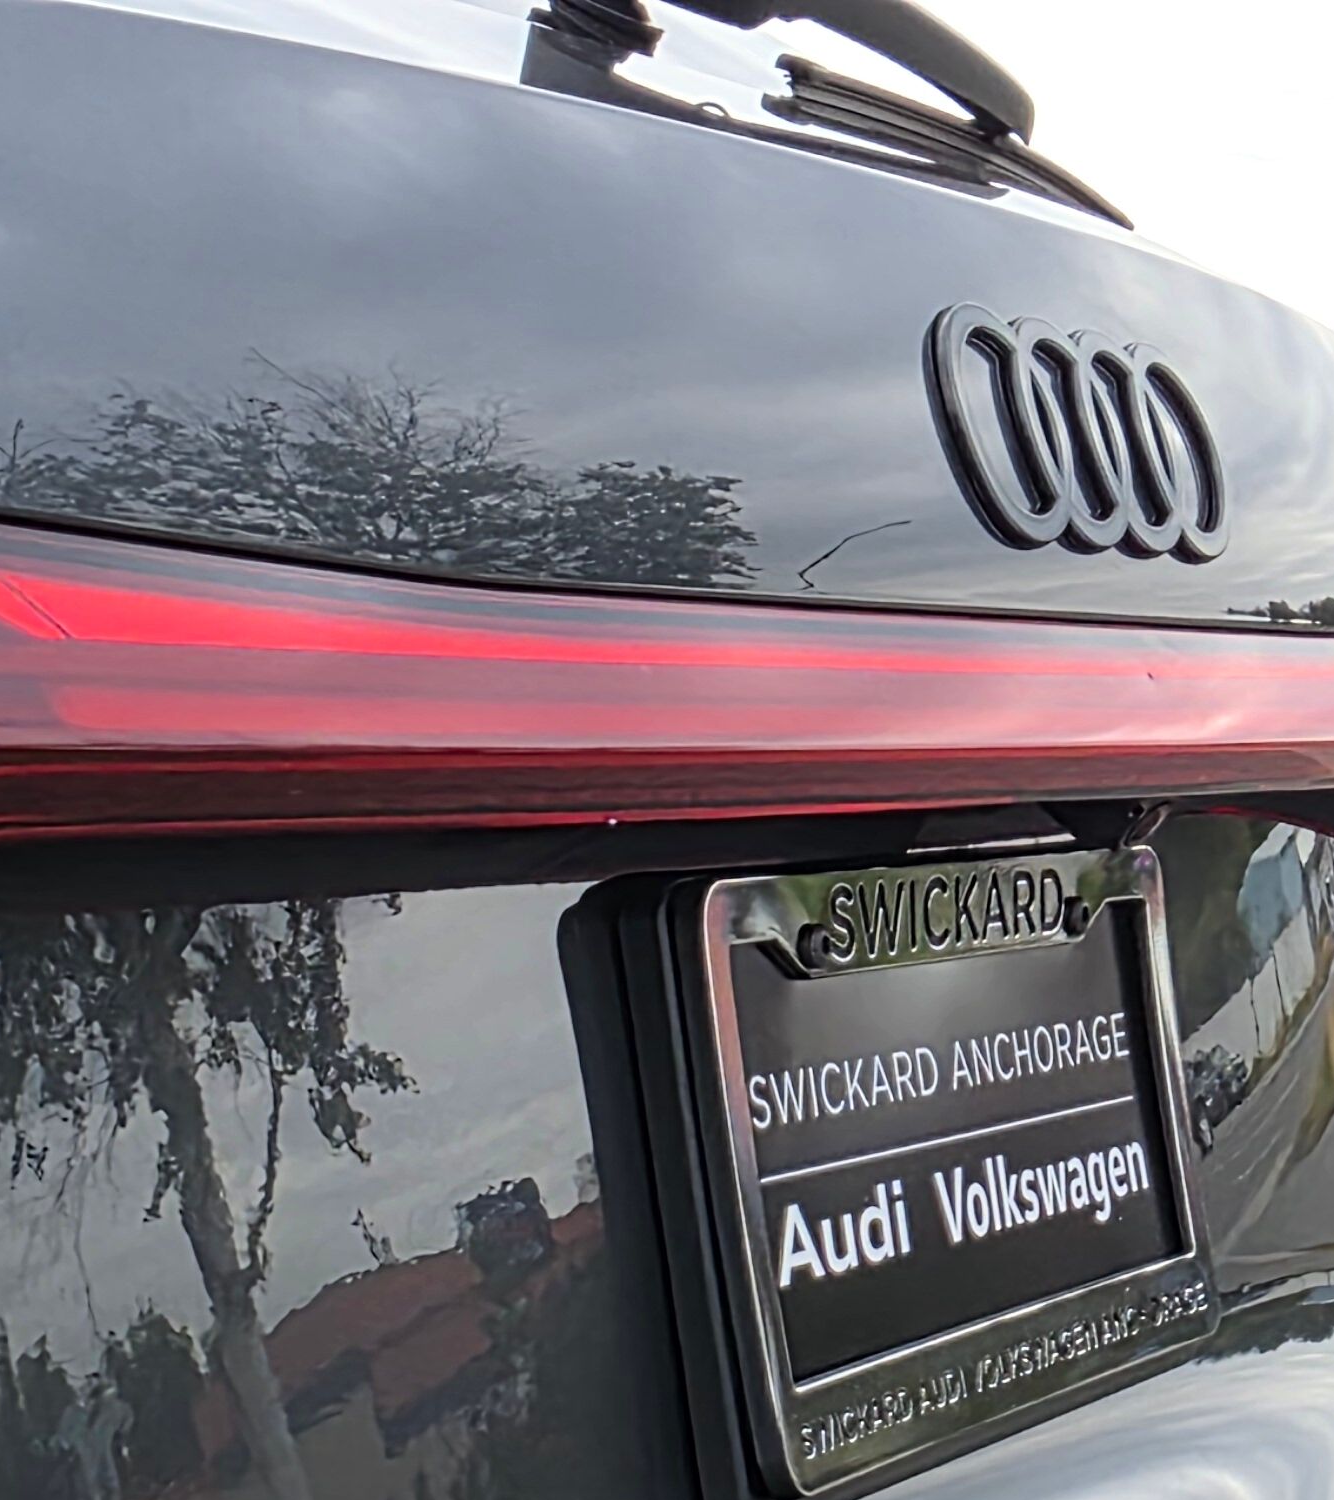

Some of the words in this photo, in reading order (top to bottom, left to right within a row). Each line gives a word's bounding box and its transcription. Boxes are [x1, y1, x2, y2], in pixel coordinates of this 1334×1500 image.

[828, 867, 1065, 963] SWICKARD
[749, 1050, 938, 1130] SWICKARD
[952, 1012, 1130, 1090] ANCHORAGE
[779, 1180, 911, 1287] Audi
[933, 1140, 1150, 1246] Volkswagen
[801, 1386, 913, 1460] SWICKARD
[1101, 1282, 1208, 1345] ANCORAGE
